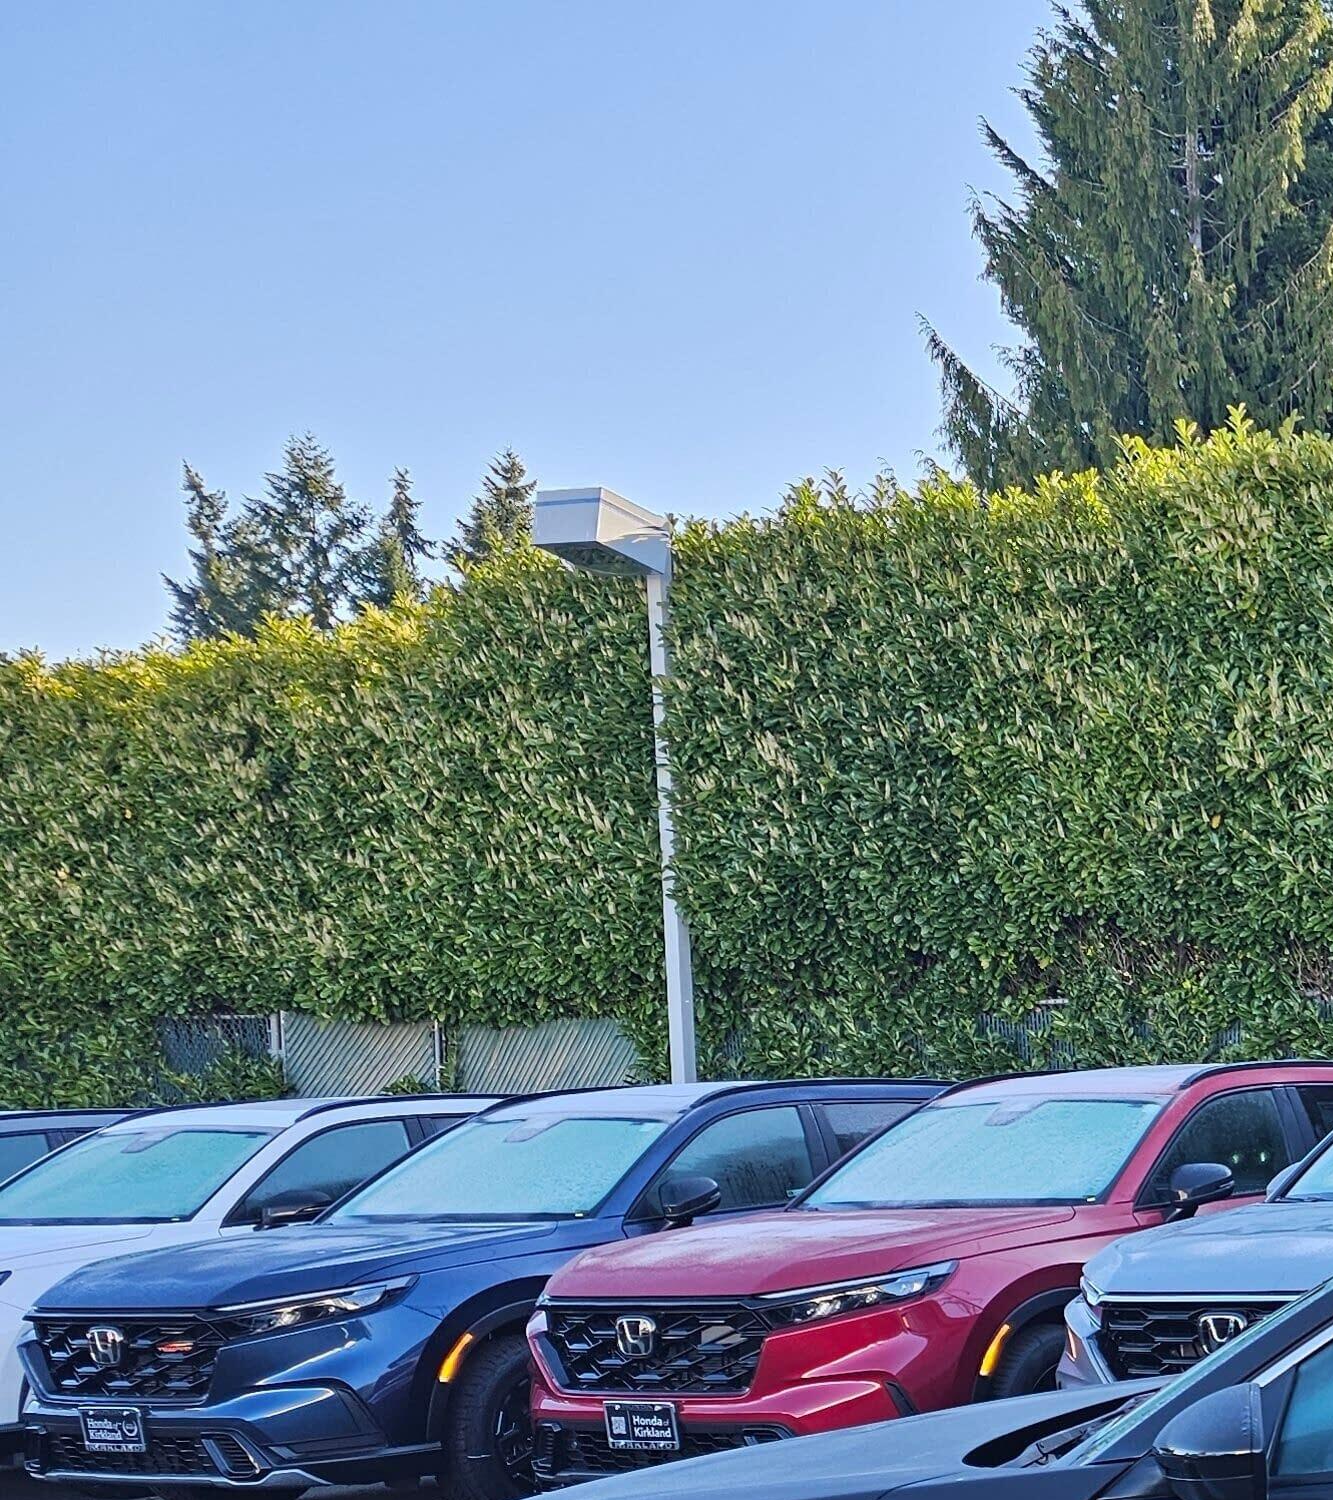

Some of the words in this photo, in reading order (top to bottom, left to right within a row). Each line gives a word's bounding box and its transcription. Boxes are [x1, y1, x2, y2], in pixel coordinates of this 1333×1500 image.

[86, 1418, 113, 1429] Honda
[632, 1415, 663, 1426] Honda
[88, 1430, 123, 1440] Kirkland
[634, 1427, 672, 1438] Kirkland
